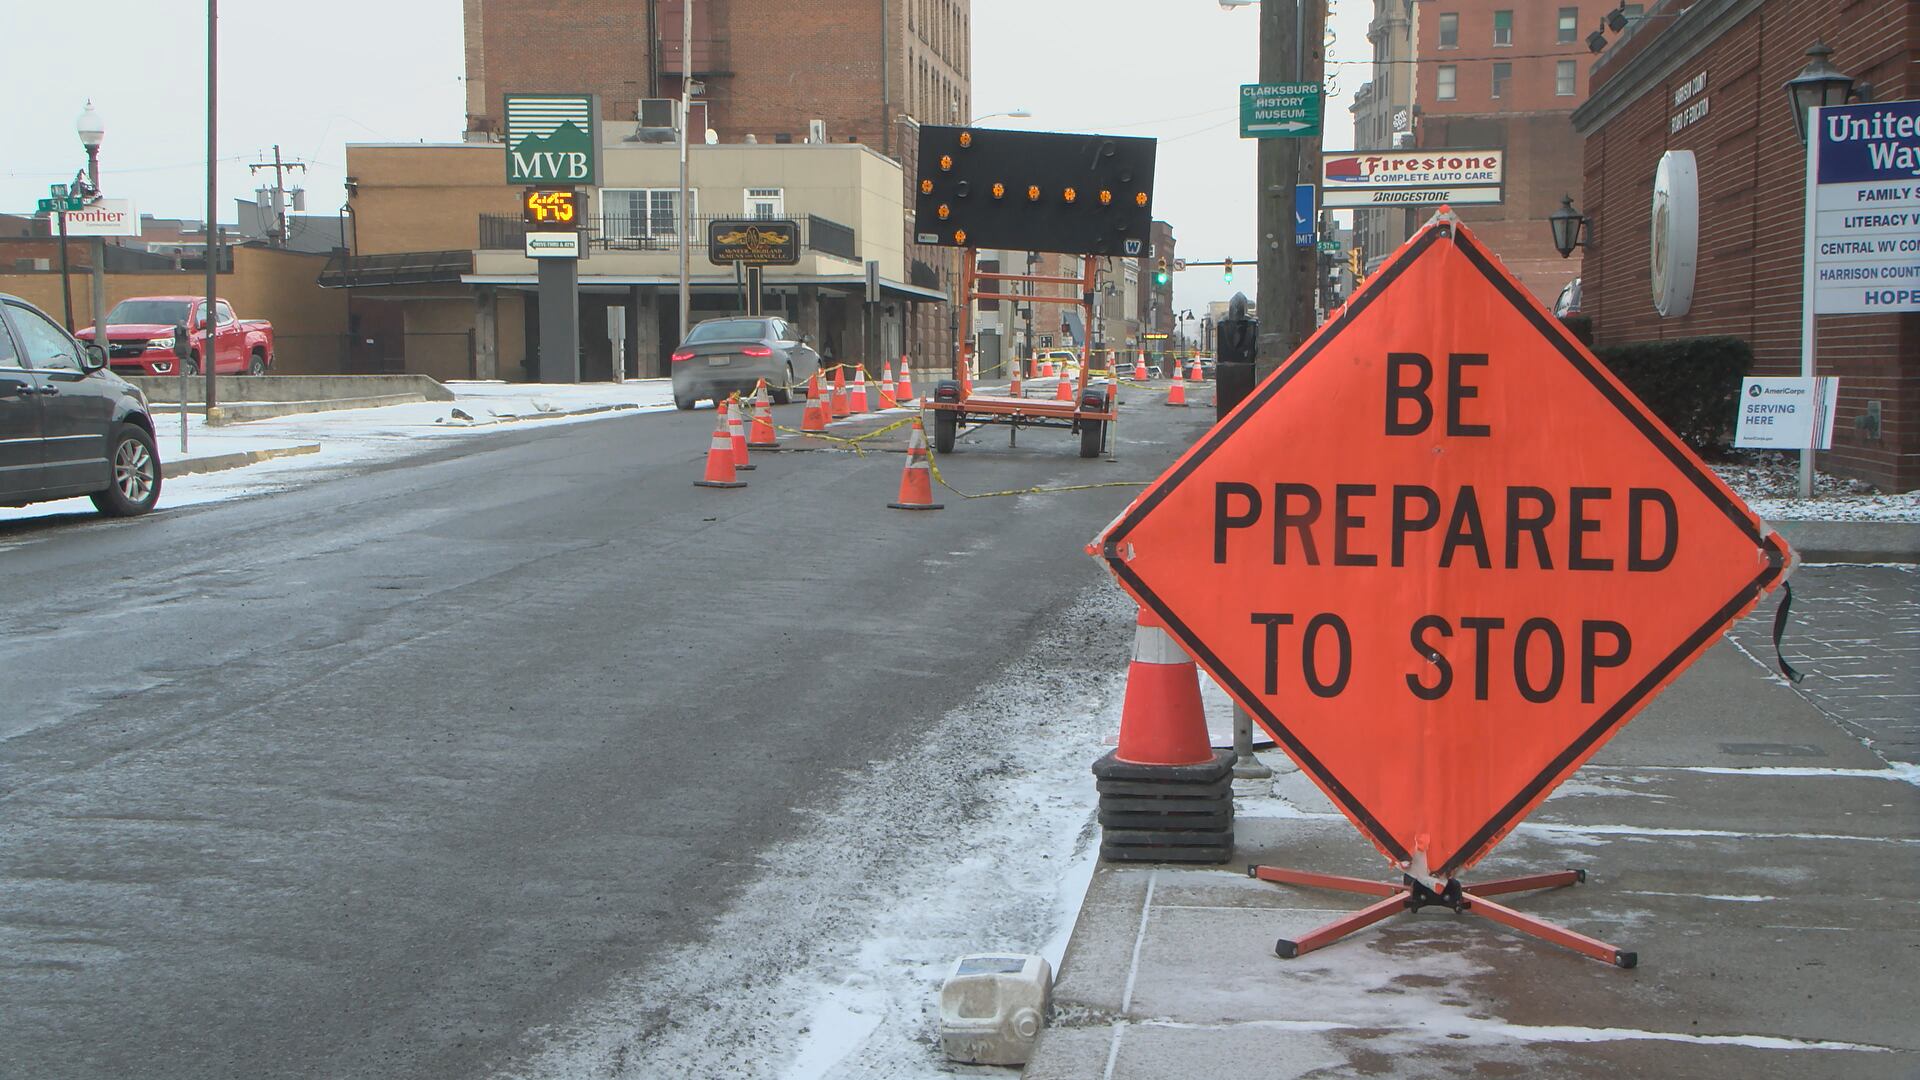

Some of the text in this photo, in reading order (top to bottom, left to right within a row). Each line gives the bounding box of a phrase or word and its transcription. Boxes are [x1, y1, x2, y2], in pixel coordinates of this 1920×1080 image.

[1243, 85, 1318, 96] CLARKSBURG
[1256, 97, 1305, 107] HISTORY
[1255, 109, 1305, 120] MUSEUM
[1827, 111, 1920, 142] Unite
[512, 152, 588, 178] MVB
[1365, 156, 1497, 176] Firestone
[1374, 173, 1429, 182] COMPLETE
[1432, 172, 1461, 181] AUTO
[1464, 171, 1493, 180] CARE
[1372, 191, 1450, 202] BRIDGESTONE
[1857, 187, 1911, 201] FAMILY
[67, 210, 124, 222] rontier
[1844, 214, 1908, 228] LITERACY
[1296, 234, 1313, 244] IMIT
[1126, 241, 1140, 253] W
[1821, 242, 1874, 255] CENTRAL
[1878, 240, 1896, 252] WV
[1820, 268, 1878, 280] HARRISON
[1865, 290, 1920, 305] HOPE
[1384, 352, 1491, 437] BE
[1764, 387, 1805, 395] AmeriCorps
[1747, 404, 1795, 413] SERVING
[1745, 416, 1774, 425] HERE
[1213, 482, 1680, 572] PREPARED
[1250, 612, 1632, 704] TO STOP
